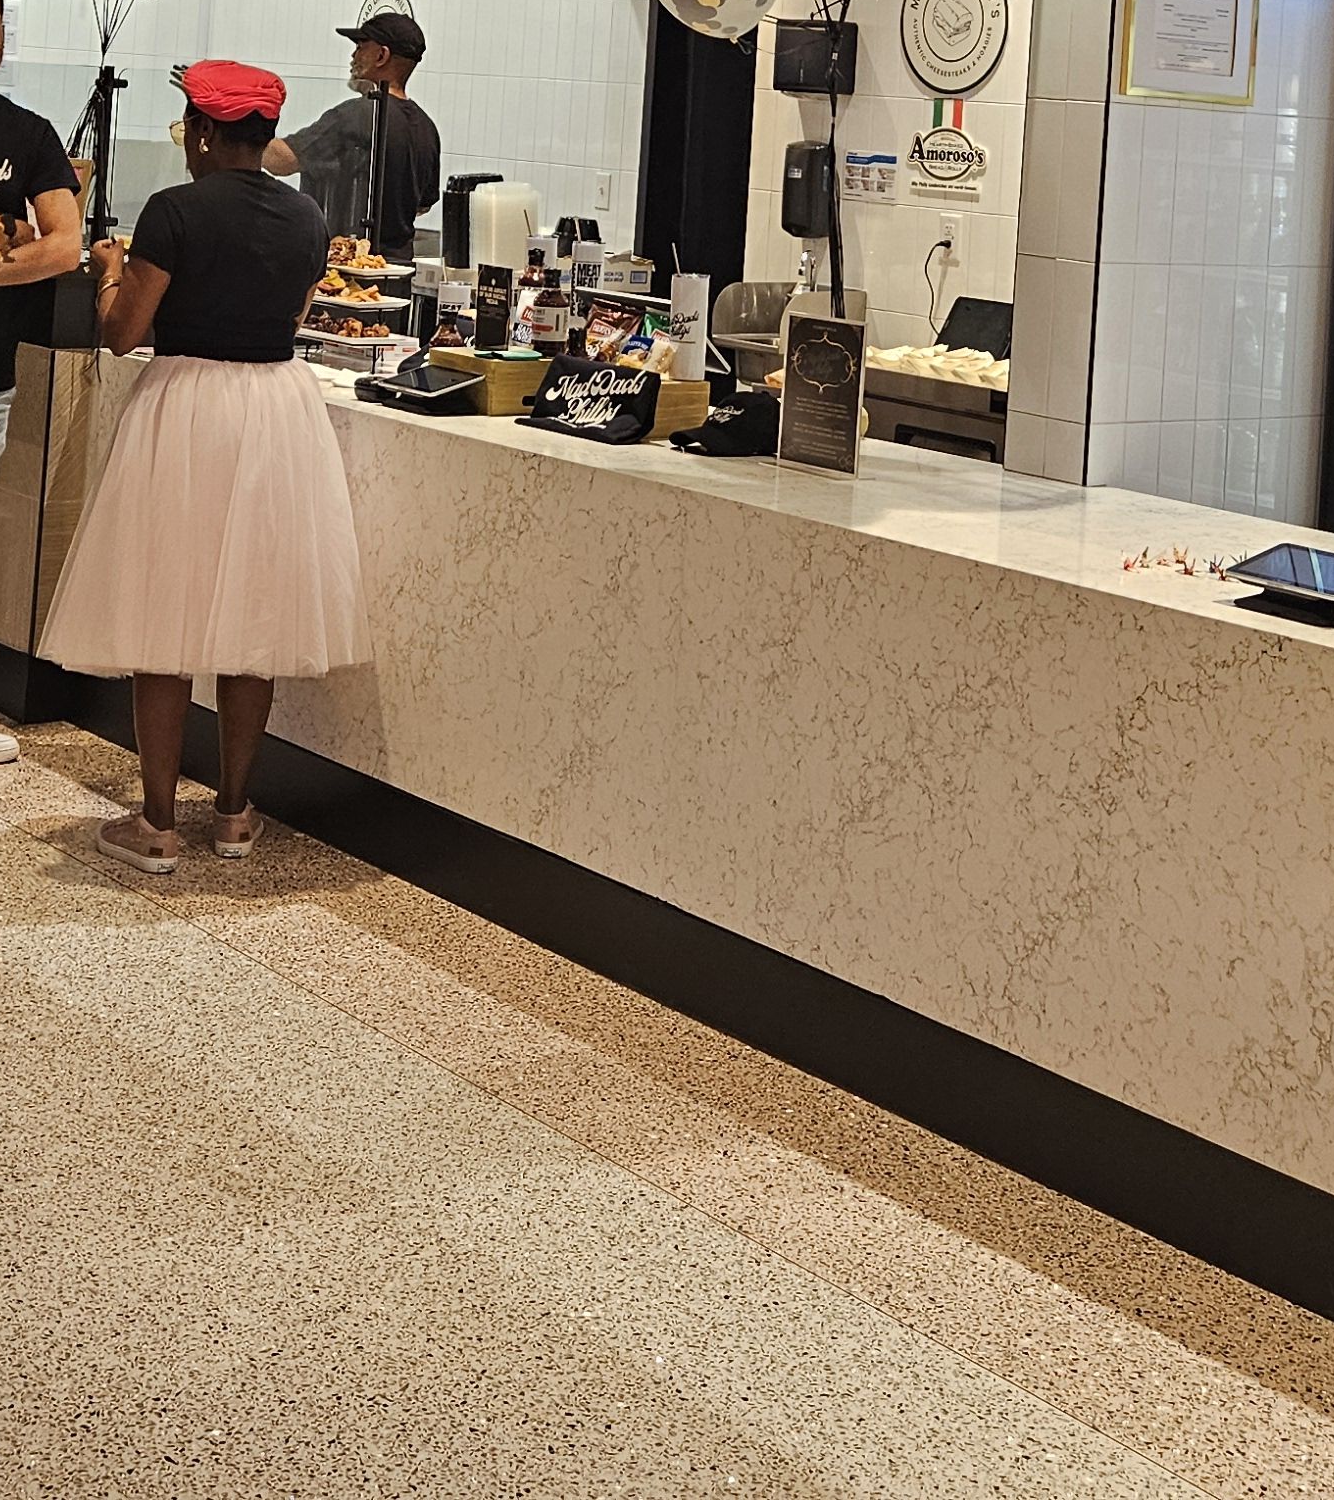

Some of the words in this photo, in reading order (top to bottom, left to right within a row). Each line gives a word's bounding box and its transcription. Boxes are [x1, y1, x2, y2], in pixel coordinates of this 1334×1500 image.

[909, 136, 984, 164] Amoroso's
[577, 263, 602, 277] MEAT
[545, 371, 598, 401] Mad
[590, 369, 648, 396] Dads
